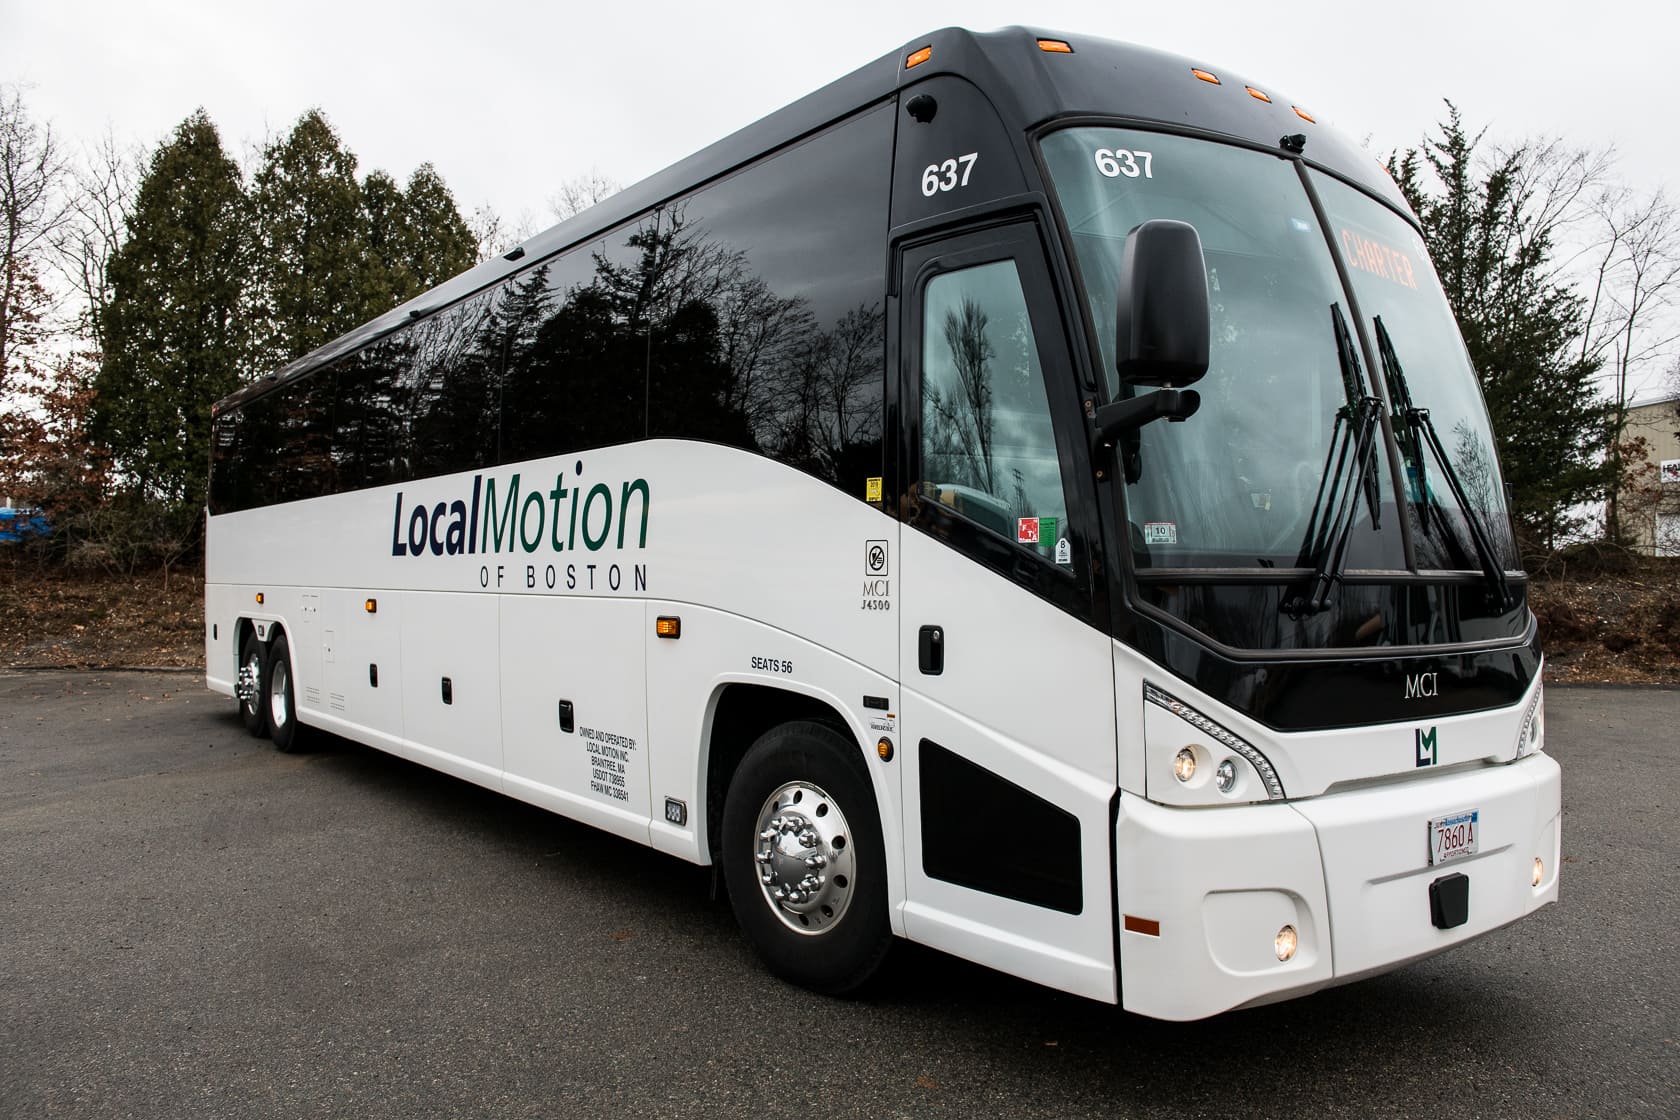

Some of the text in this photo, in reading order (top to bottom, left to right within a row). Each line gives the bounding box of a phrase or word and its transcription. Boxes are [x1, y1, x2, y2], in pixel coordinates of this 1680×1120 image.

[921, 152, 979, 197] 637
[1094, 148, 1154, 179] 637
[1342, 229, 1418, 289] CHARTER
[480, 564, 648, 592] OF BOSTON
[862, 580, 891, 597] MCI
[861, 600, 890, 611] J4500
[751, 656, 793, 674] SEATS 56
[1404, 672, 1438, 699] MCI
[579, 726, 637, 751] OWNED AND OPERATED BY:
[586, 741, 630, 763] LOCAL MOTION INC.
[592, 767, 609, 783] USDOT
[617, 762, 626, 775] MA
[604, 784, 613, 797] MC
[1437, 824, 1465, 853] 7860
[1467, 821, 1474, 845] A
